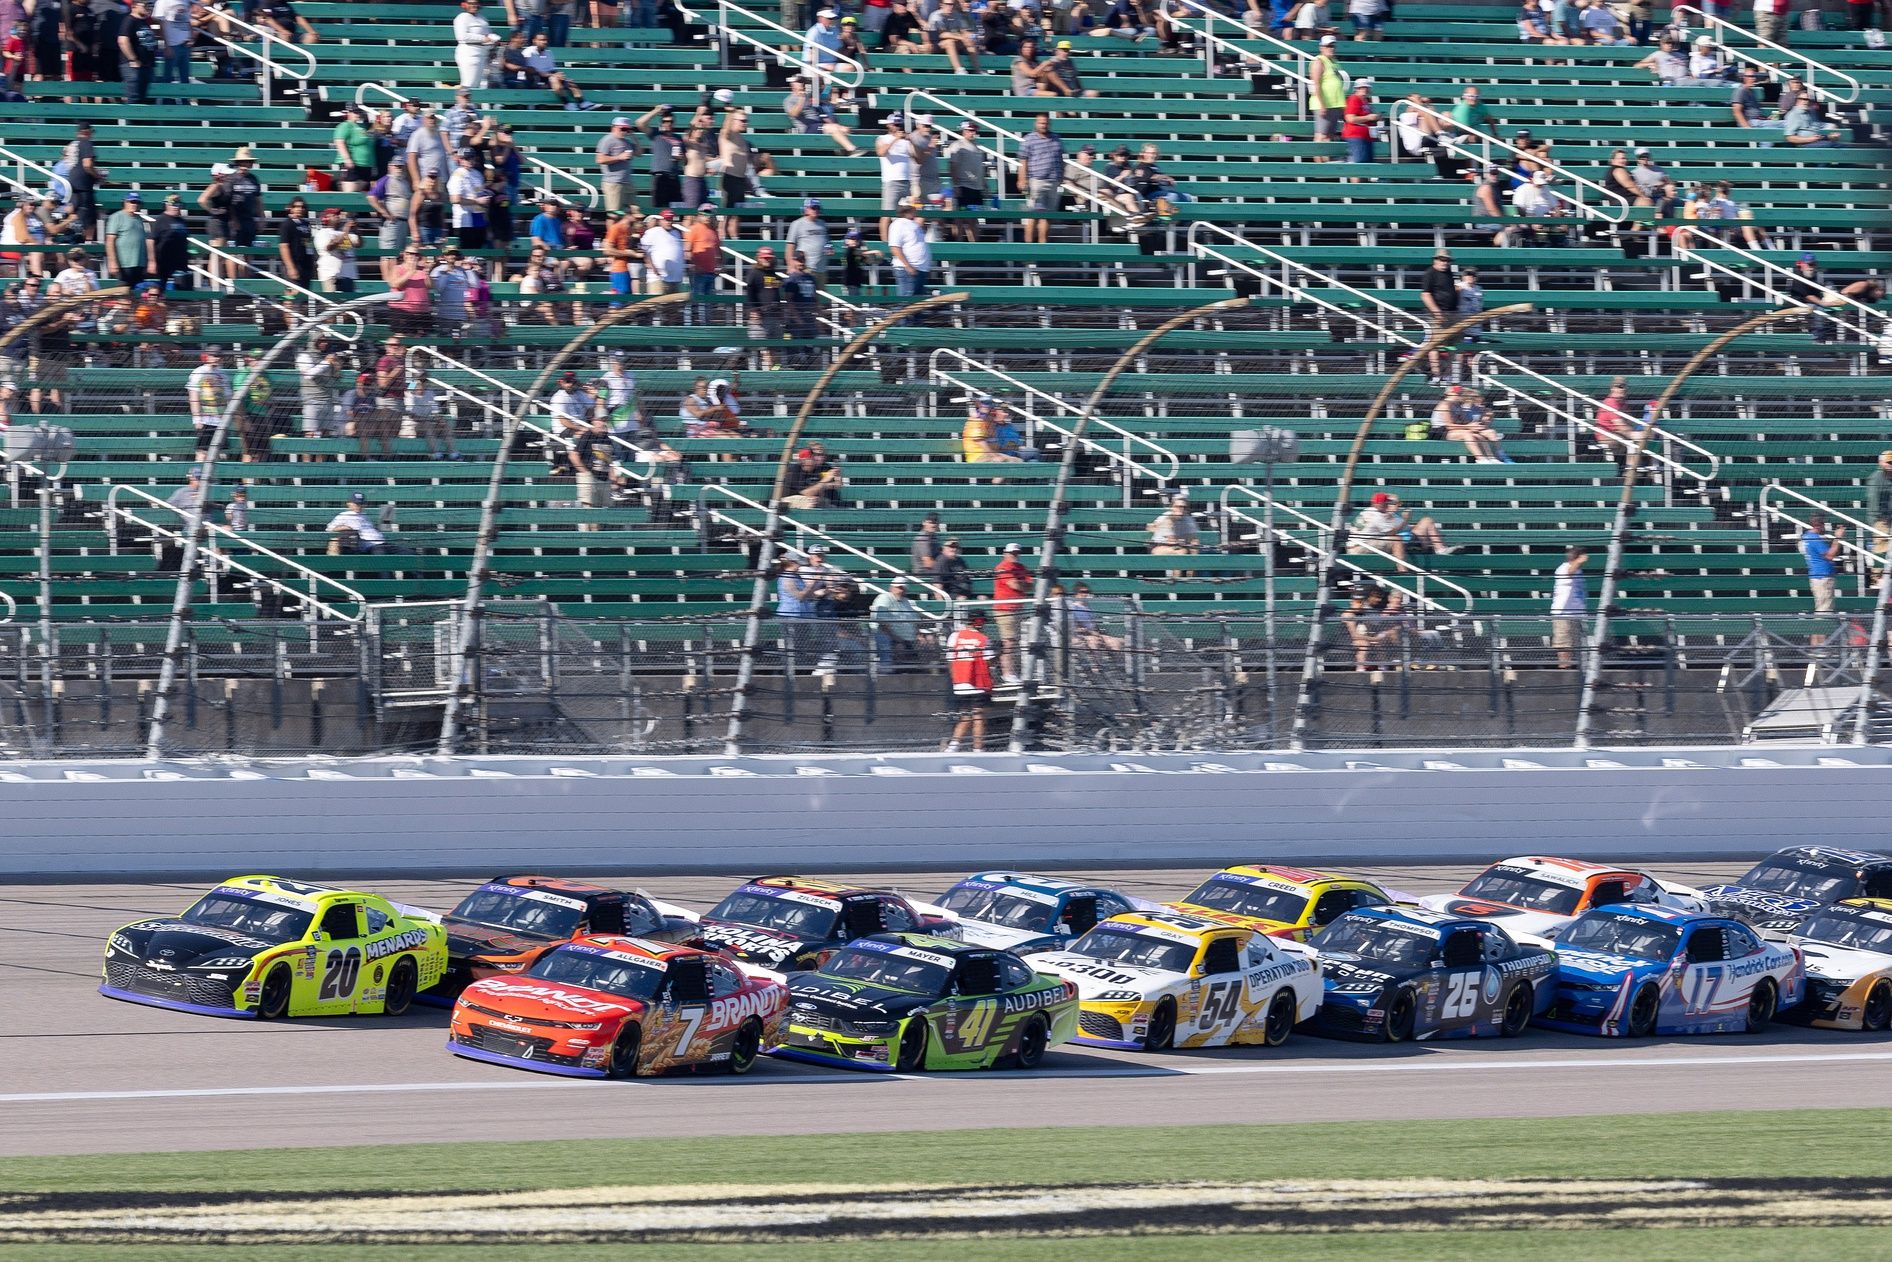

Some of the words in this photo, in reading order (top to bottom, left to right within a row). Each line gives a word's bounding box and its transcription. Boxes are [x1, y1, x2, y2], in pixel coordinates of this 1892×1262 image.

[1494, 864, 1527, 874] xfinity
[1797, 859, 1829, 869] xfinity
[1219, 873, 1250, 883] xfinity
[488, 884, 521, 895] xfinity
[744, 886, 776, 895] xfinity
[963, 881, 996, 890] xfinity
[1268, 881, 1297, 892] CREED
[219, 887, 253, 896] xfinity
[1021, 890, 1037, 899] HILL
[274, 896, 302, 907] JONES
[543, 894, 573, 905] SMITH
[797, 895, 832, 906] ZILISCH
[1828, 905, 1861, 915] xfinity
[1344, 915, 1378, 924] xfinity
[1614, 915, 1649, 925] xfinity
[1105, 922, 1137, 931] xfinity
[364, 927, 428, 960] MENARDS
[704, 925, 804, 953] ROLINA
[567, 944, 600, 954] xfinity
[856, 940, 890, 951] xfinity
[617, 953, 661, 968] ALLGAIER
[908, 950, 942, 963] MAYER
[318, 946, 362, 1002] 20
[1249, 961, 1295, 988] OPERATION
[1726, 958, 1765, 984] Hendrick
[472, 979, 632, 1013] BRANDT
[1441, 971, 1481, 1019] 26
[1685, 965, 1725, 1016] 17
[789, 985, 888, 1014] DIBEL
[1004, 986, 1068, 1014] AUDIBEL
[1199, 980, 1243, 1030] 54
[706, 983, 781, 1031] BRANDT
[958, 998, 998, 1048] 41
[673, 1007, 705, 1057] 7
